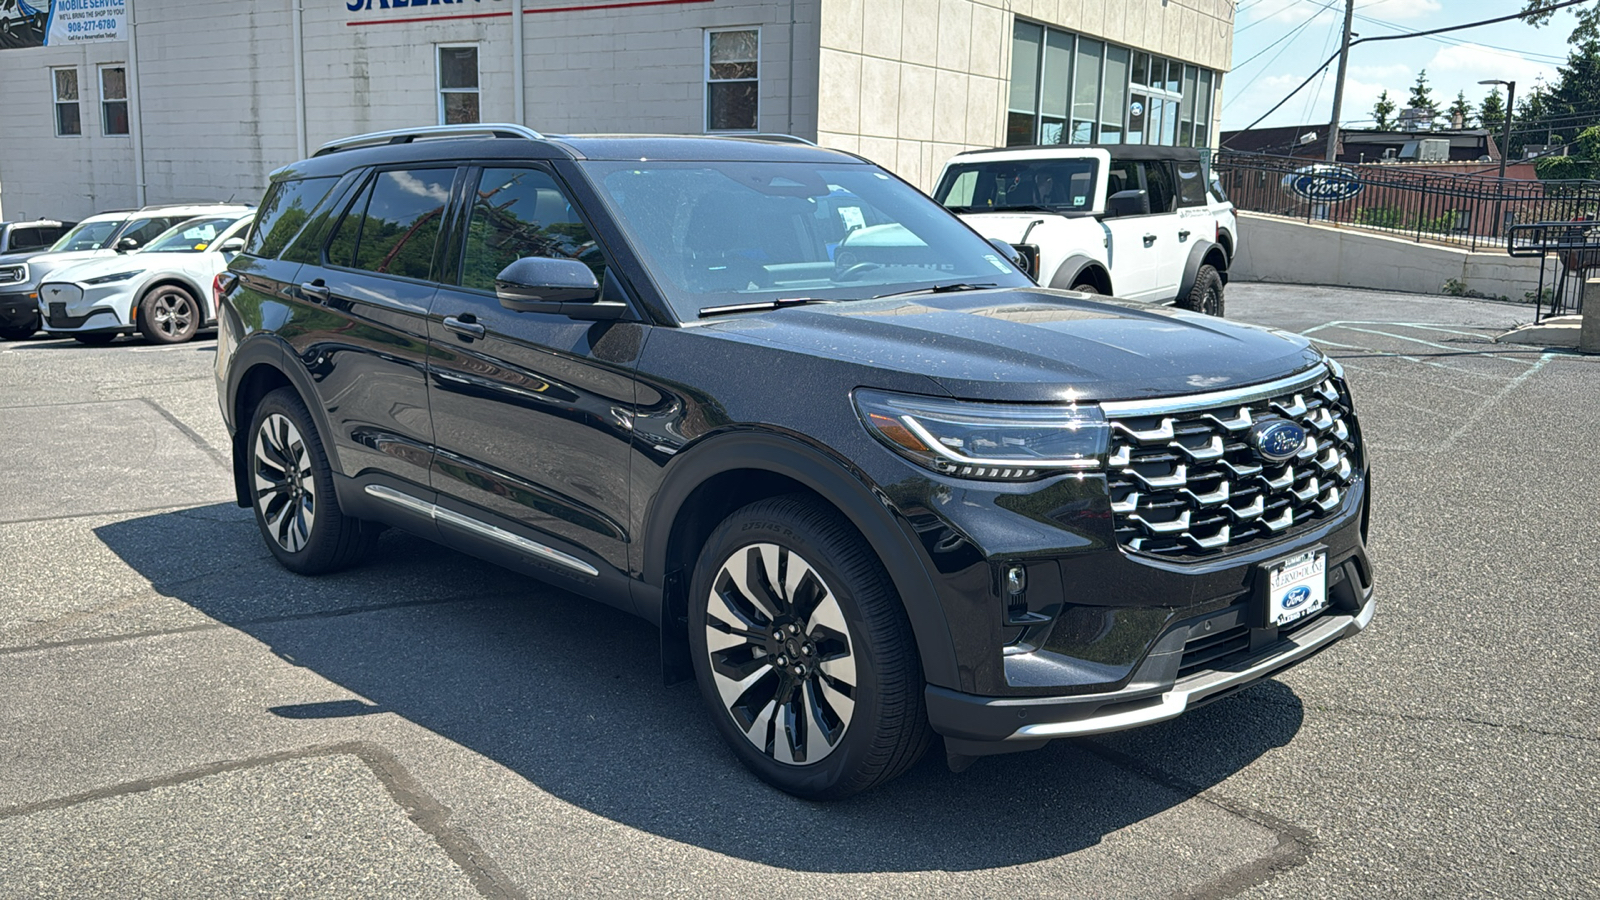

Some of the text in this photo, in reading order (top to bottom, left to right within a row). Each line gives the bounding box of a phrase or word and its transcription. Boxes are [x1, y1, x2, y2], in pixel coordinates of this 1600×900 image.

[59, 0, 88, 11] MOBILE
[68, 19, 116, 32] 908-277-6780
[1306, 174, 1350, 195] Ford
[1273, 430, 1299, 453] Ford
[741, 521, 782, 534] 275/45
[1286, 588, 1306, 608] Ford
